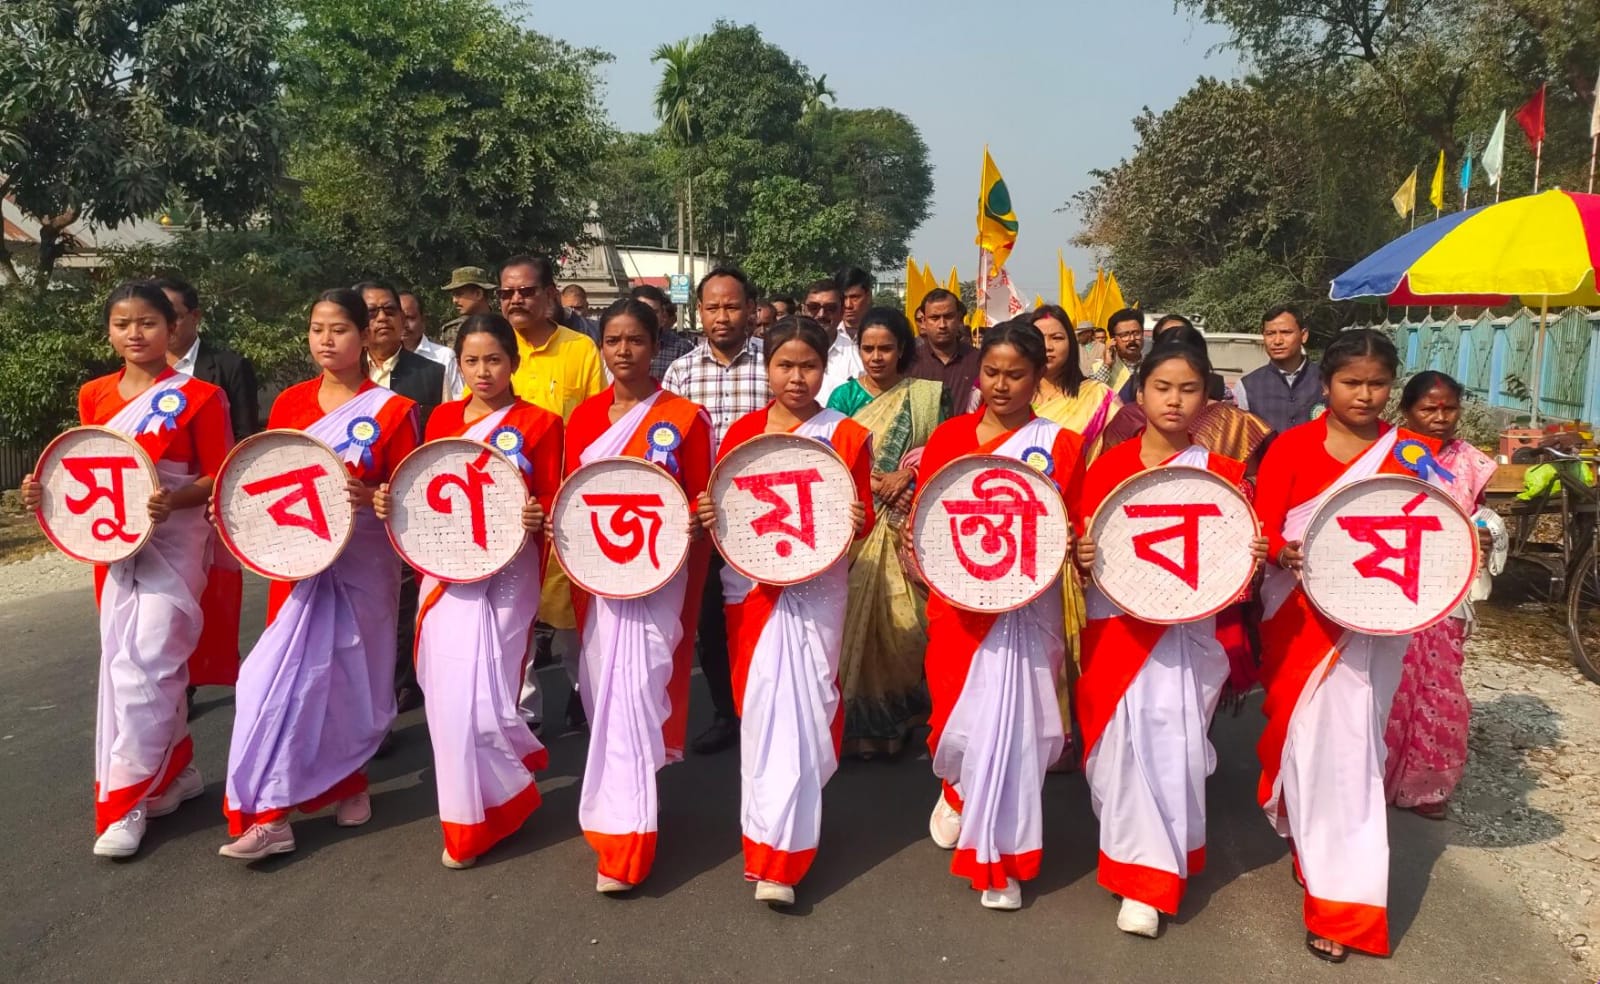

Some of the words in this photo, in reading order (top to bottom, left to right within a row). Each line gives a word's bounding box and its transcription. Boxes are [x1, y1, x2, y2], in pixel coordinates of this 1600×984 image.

[61, 456, 139, 543] সু
[241, 464, 331, 541] ব
[581, 493, 664, 570] জ
[732, 468, 823, 557] য়
[941, 468, 1048, 581] ন্তী
[1123, 503, 1223, 591] ব
